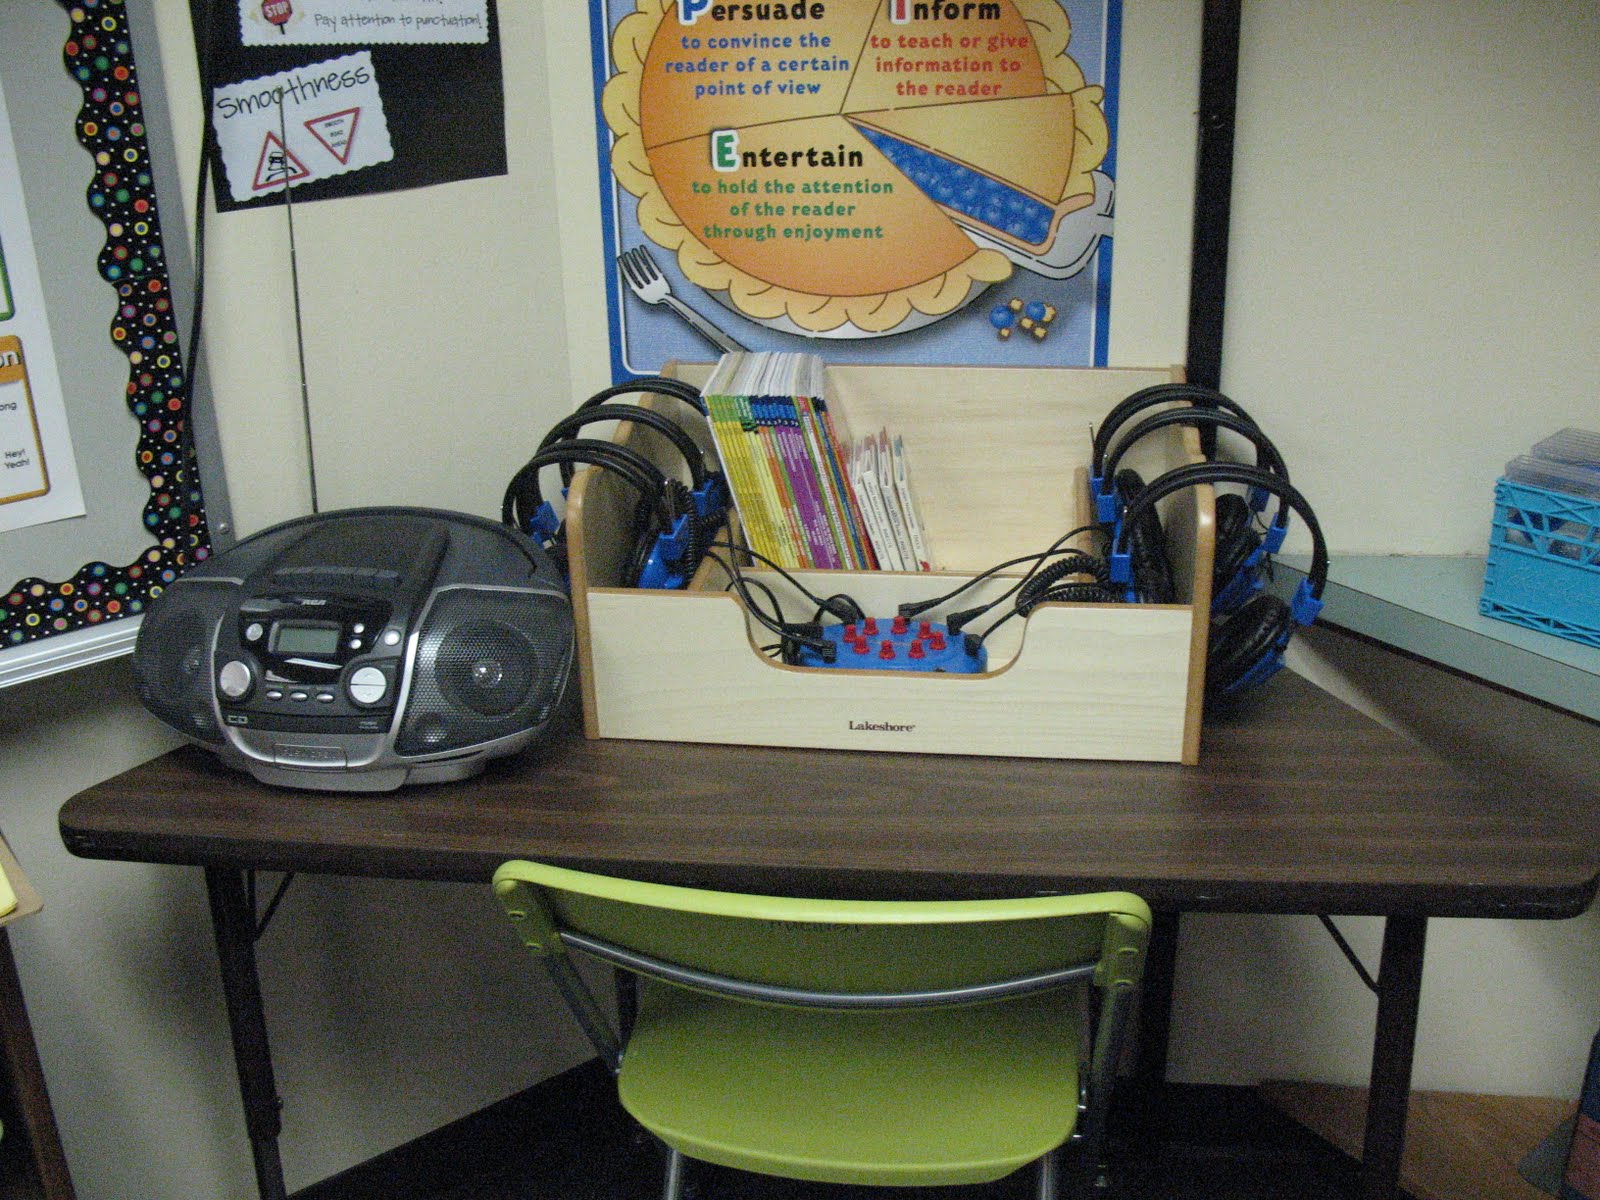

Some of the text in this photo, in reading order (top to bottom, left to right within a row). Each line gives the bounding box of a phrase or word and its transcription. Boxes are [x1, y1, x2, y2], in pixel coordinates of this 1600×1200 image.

[678, 0, 826, 22] Persuade
[894, 0, 1001, 22] Inform
[314, 13, 482, 32] Pay attention to punctuation!
[681, 34, 832, 50] to convince the
[870, 33, 1030, 53] to teach or give
[665, 57, 849, 73] reader of a certain
[876, 57, 1022, 73] information to
[215, 66, 371, 119] Smoothness
[694, 80, 822, 99] point of view
[896, 80, 1003, 96] the reader
[713, 131, 864, 169] Entertain
[692, 179, 894, 195] to hold the attention
[729, 202, 857, 217] of the reader
[703, 225, 884, 243] through enjoyment
[5, 449, 26, 460] Hey!
[4, 458, 30, 470] Yeah!
[848, 720, 914, 732] Lakeshore
